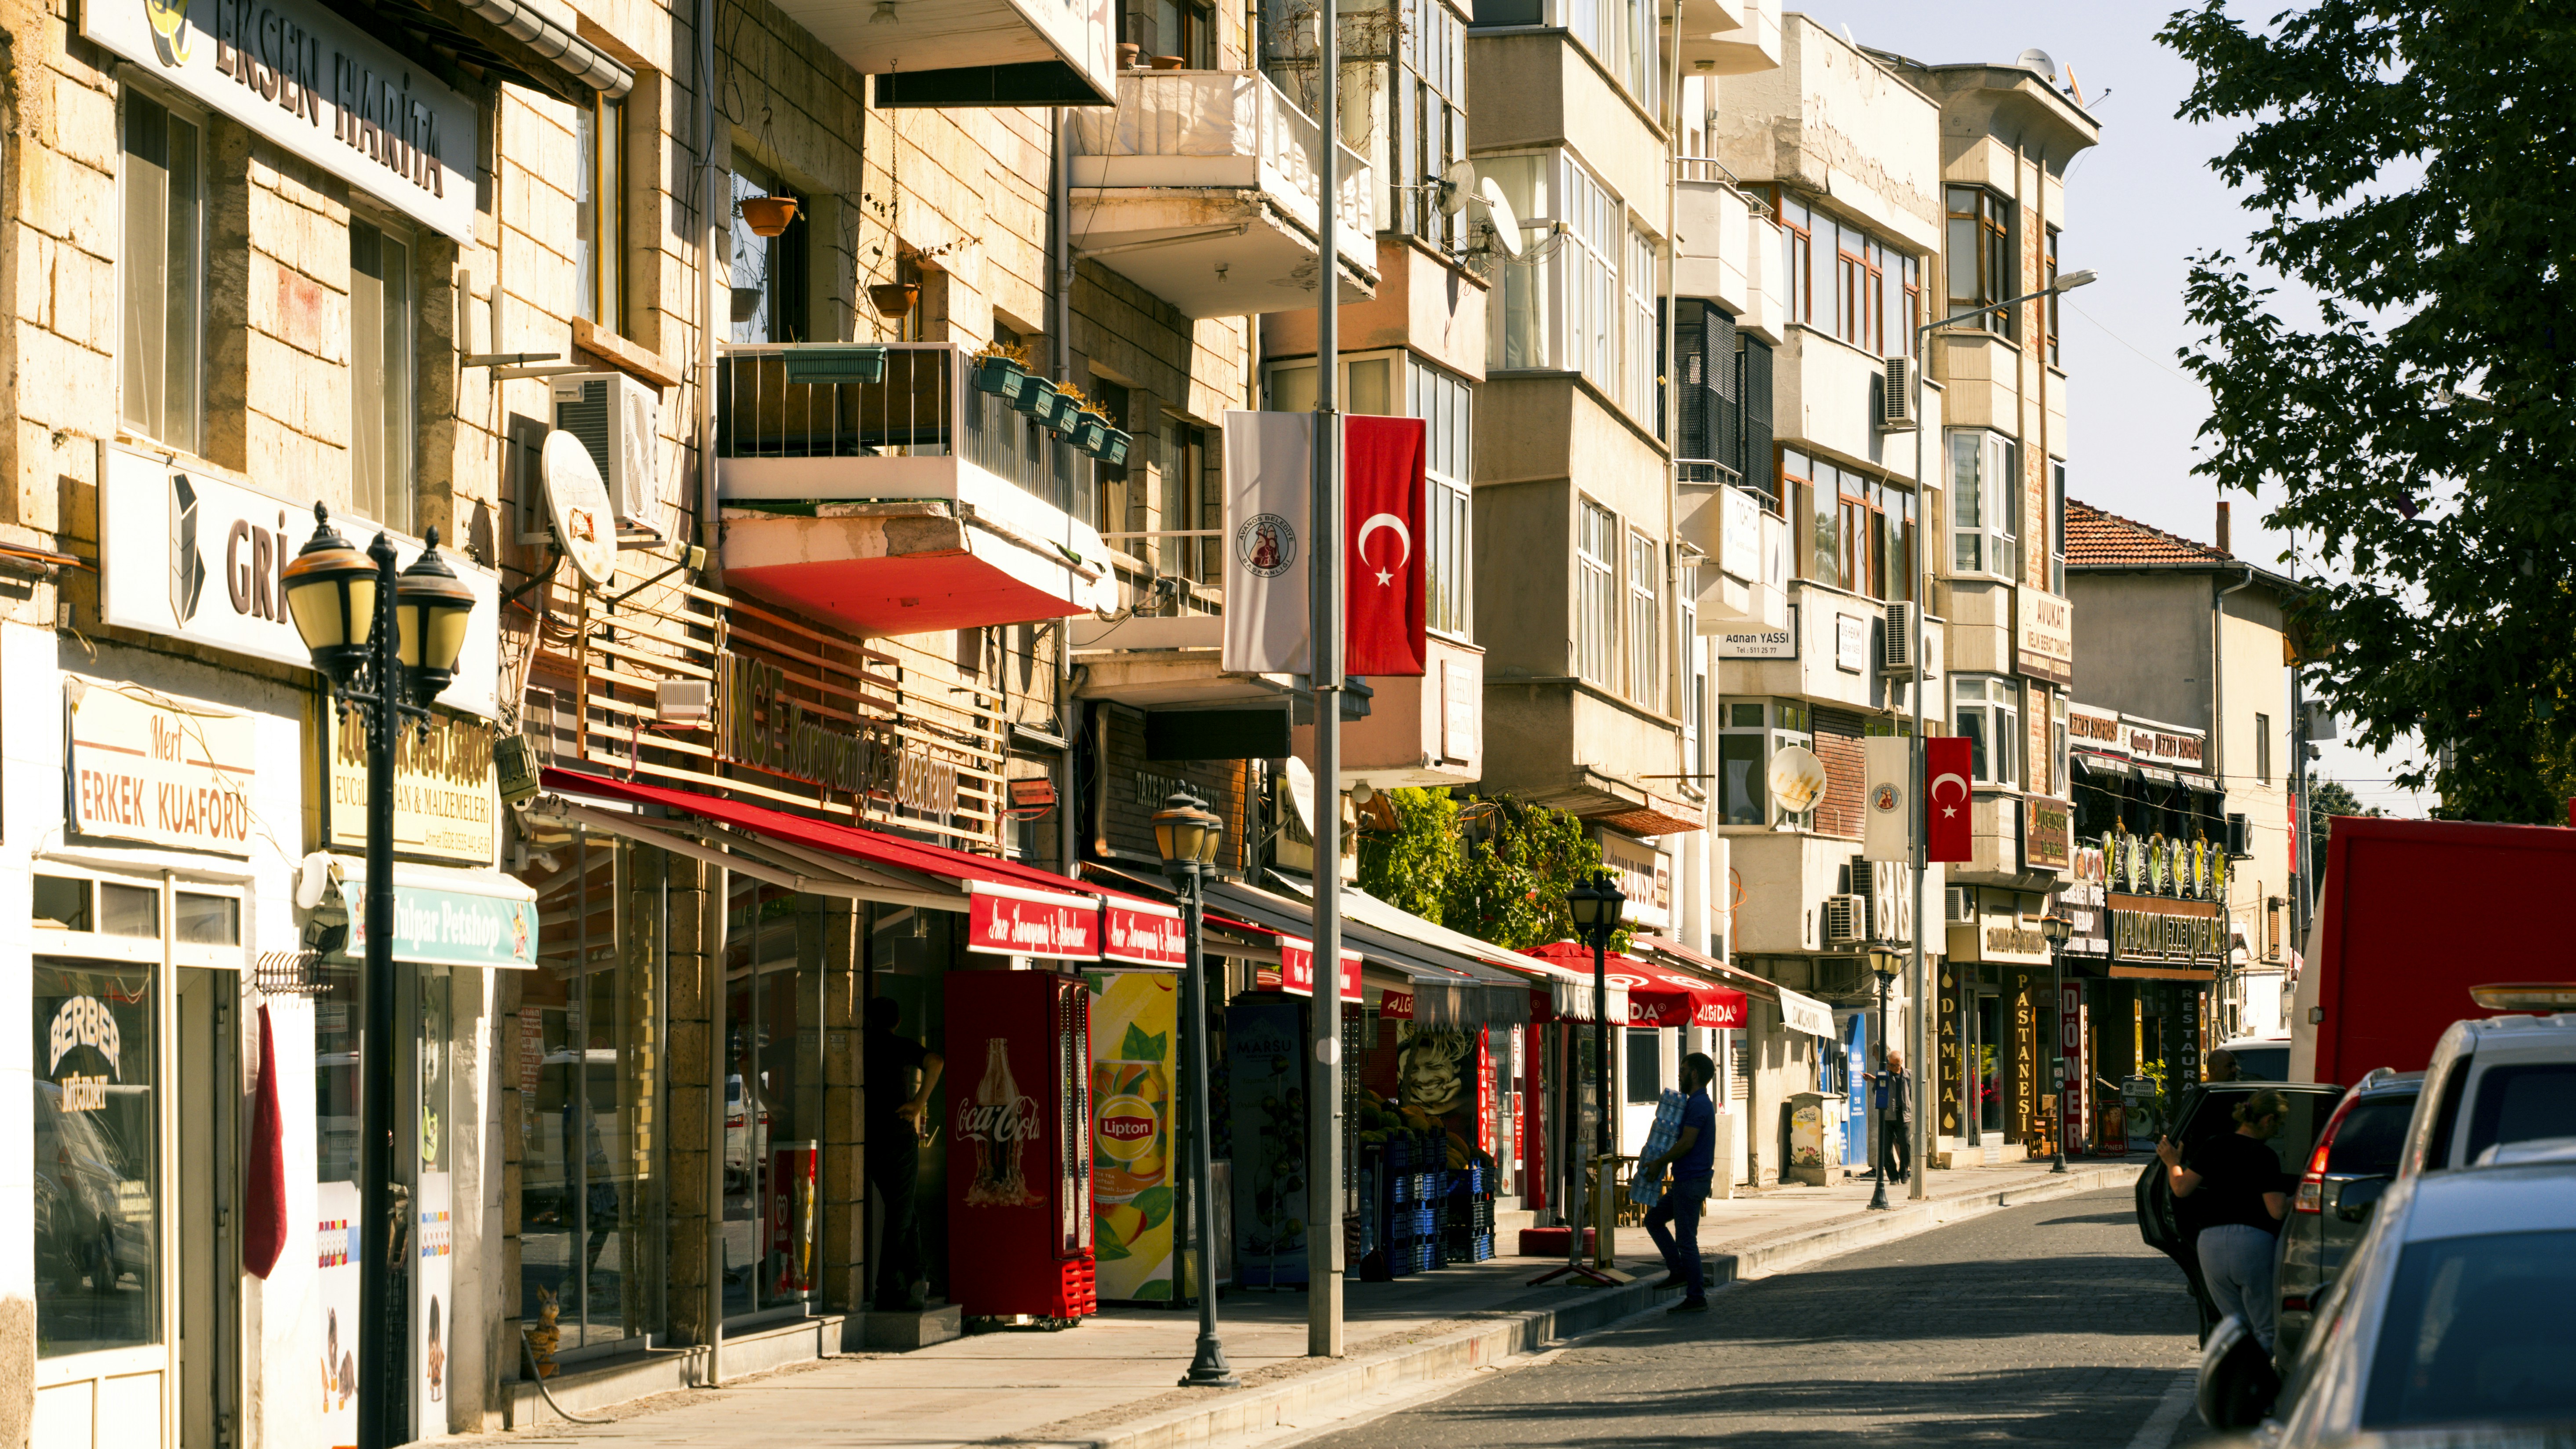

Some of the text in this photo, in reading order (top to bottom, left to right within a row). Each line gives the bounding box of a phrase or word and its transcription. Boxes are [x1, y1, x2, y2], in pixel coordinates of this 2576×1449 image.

[216, 0, 444, 198] EKSEN HARİTA
[1239, 513, 1294, 543] AVANOS BELEDİYE
[1242, 557, 1291, 577] BAŞKANLIĞI
[2038, 599, 2064, 630] AVUKAT
[1726, 633, 1789, 644] Adnan YASSI
[2028, 628, 2070, 658] MELİK BERAT TANKUT
[719, 614, 959, 821] İNCE Kuruyemiş & Şekerleme
[2069, 712, 2118, 743] LEZZET SOFRASI
[150, 715, 182, 763] Mert
[2155, 733, 2178, 757] LEZZET
[2178, 736, 2202, 760] SOFRASI
[81, 769, 248, 843] ERKEK KUAFÖRÜ
[415, 786, 421, 814] &
[1136, 772, 1158, 809] TAZE
[426, 827, 490, 854] Ahmet İĞDE 0535 441 45 68
[1637, 862, 1655, 907] USTA
[393, 897, 500, 950] Tulpar Petshop
[1050, 913, 1057, 945] &
[2074, 910, 2094, 932] KEBAP
[2114, 909, 2222, 966] KAPADOKYA LEZZET SOFRASI
[1158, 923, 1164, 952] &
[1164, 918, 1186, 962] Şekerlem
[50, 995, 121, 1082] BERBER
[1237, 1039, 1291, 1054] MARSU
[1941, 998, 1955, 1103] DAMLA
[2016, 974, 2030, 1133] PASTANESİ
[2180, 989, 2196, 1092] RESTAURA
[2063, 988, 2082, 1149] DÖNER
[62, 1071, 108, 1113] MÜJDAT
[956, 1095, 1041, 1143] Coca-Cola
[1104, 1121, 1149, 1137] Lipton
[2104, 1143, 2123, 1151] ÖNER
[1094, 1177, 1114, 1186] Şeftali
